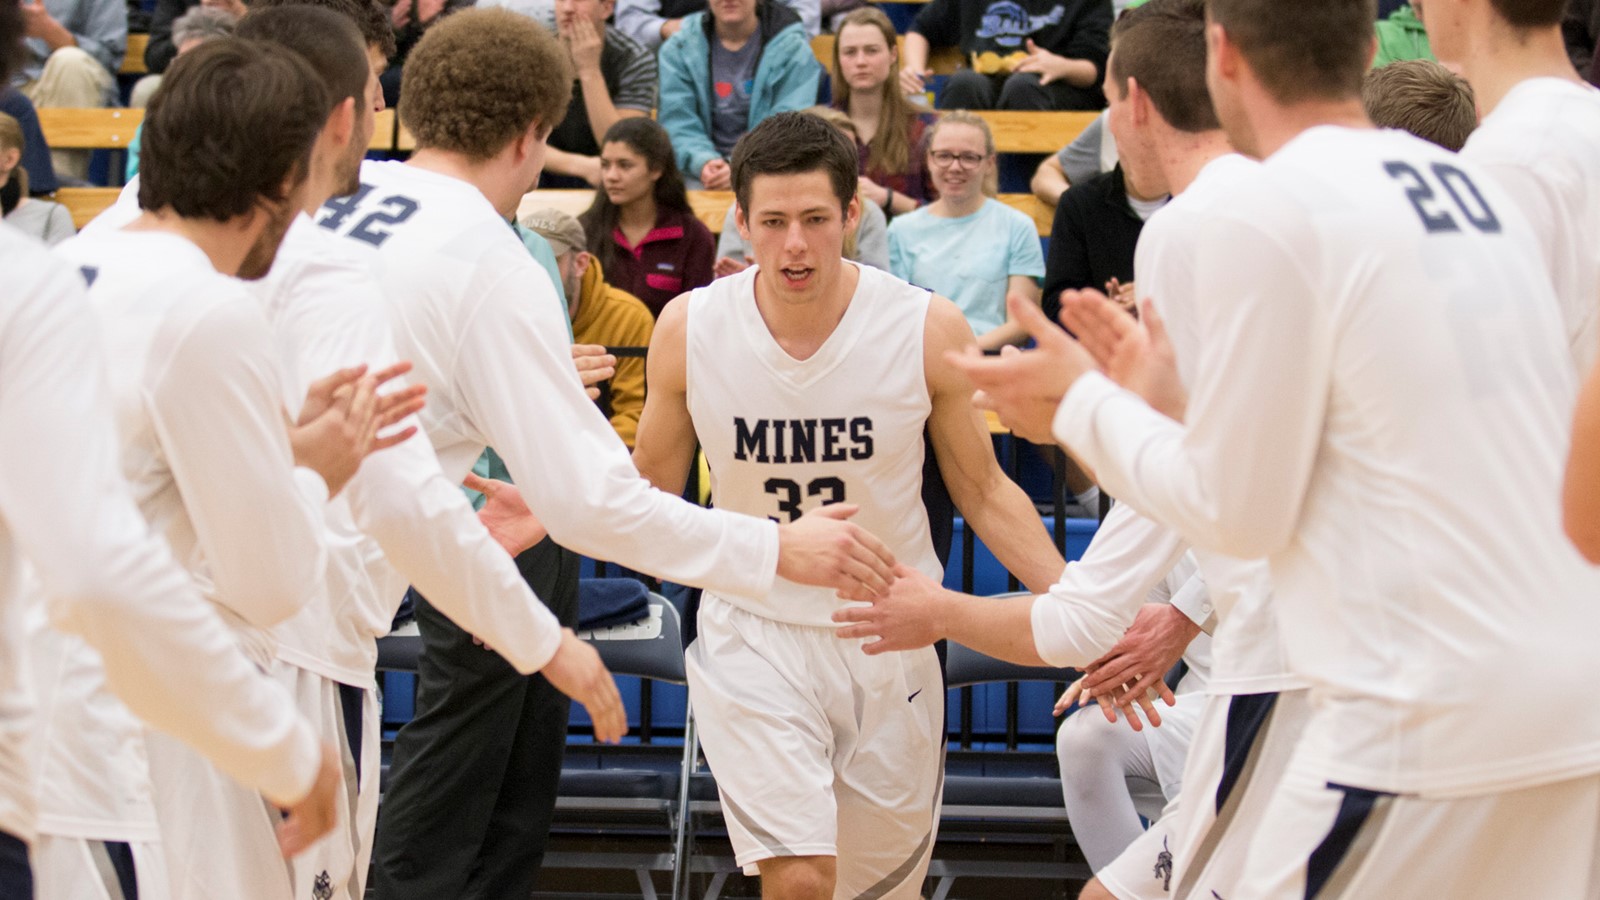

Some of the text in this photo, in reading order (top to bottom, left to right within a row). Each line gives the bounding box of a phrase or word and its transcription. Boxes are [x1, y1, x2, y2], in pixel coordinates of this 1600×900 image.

[318, 182, 421, 249] 42
[1382, 160, 1503, 234] 20
[733, 416, 874, 464] MINES
